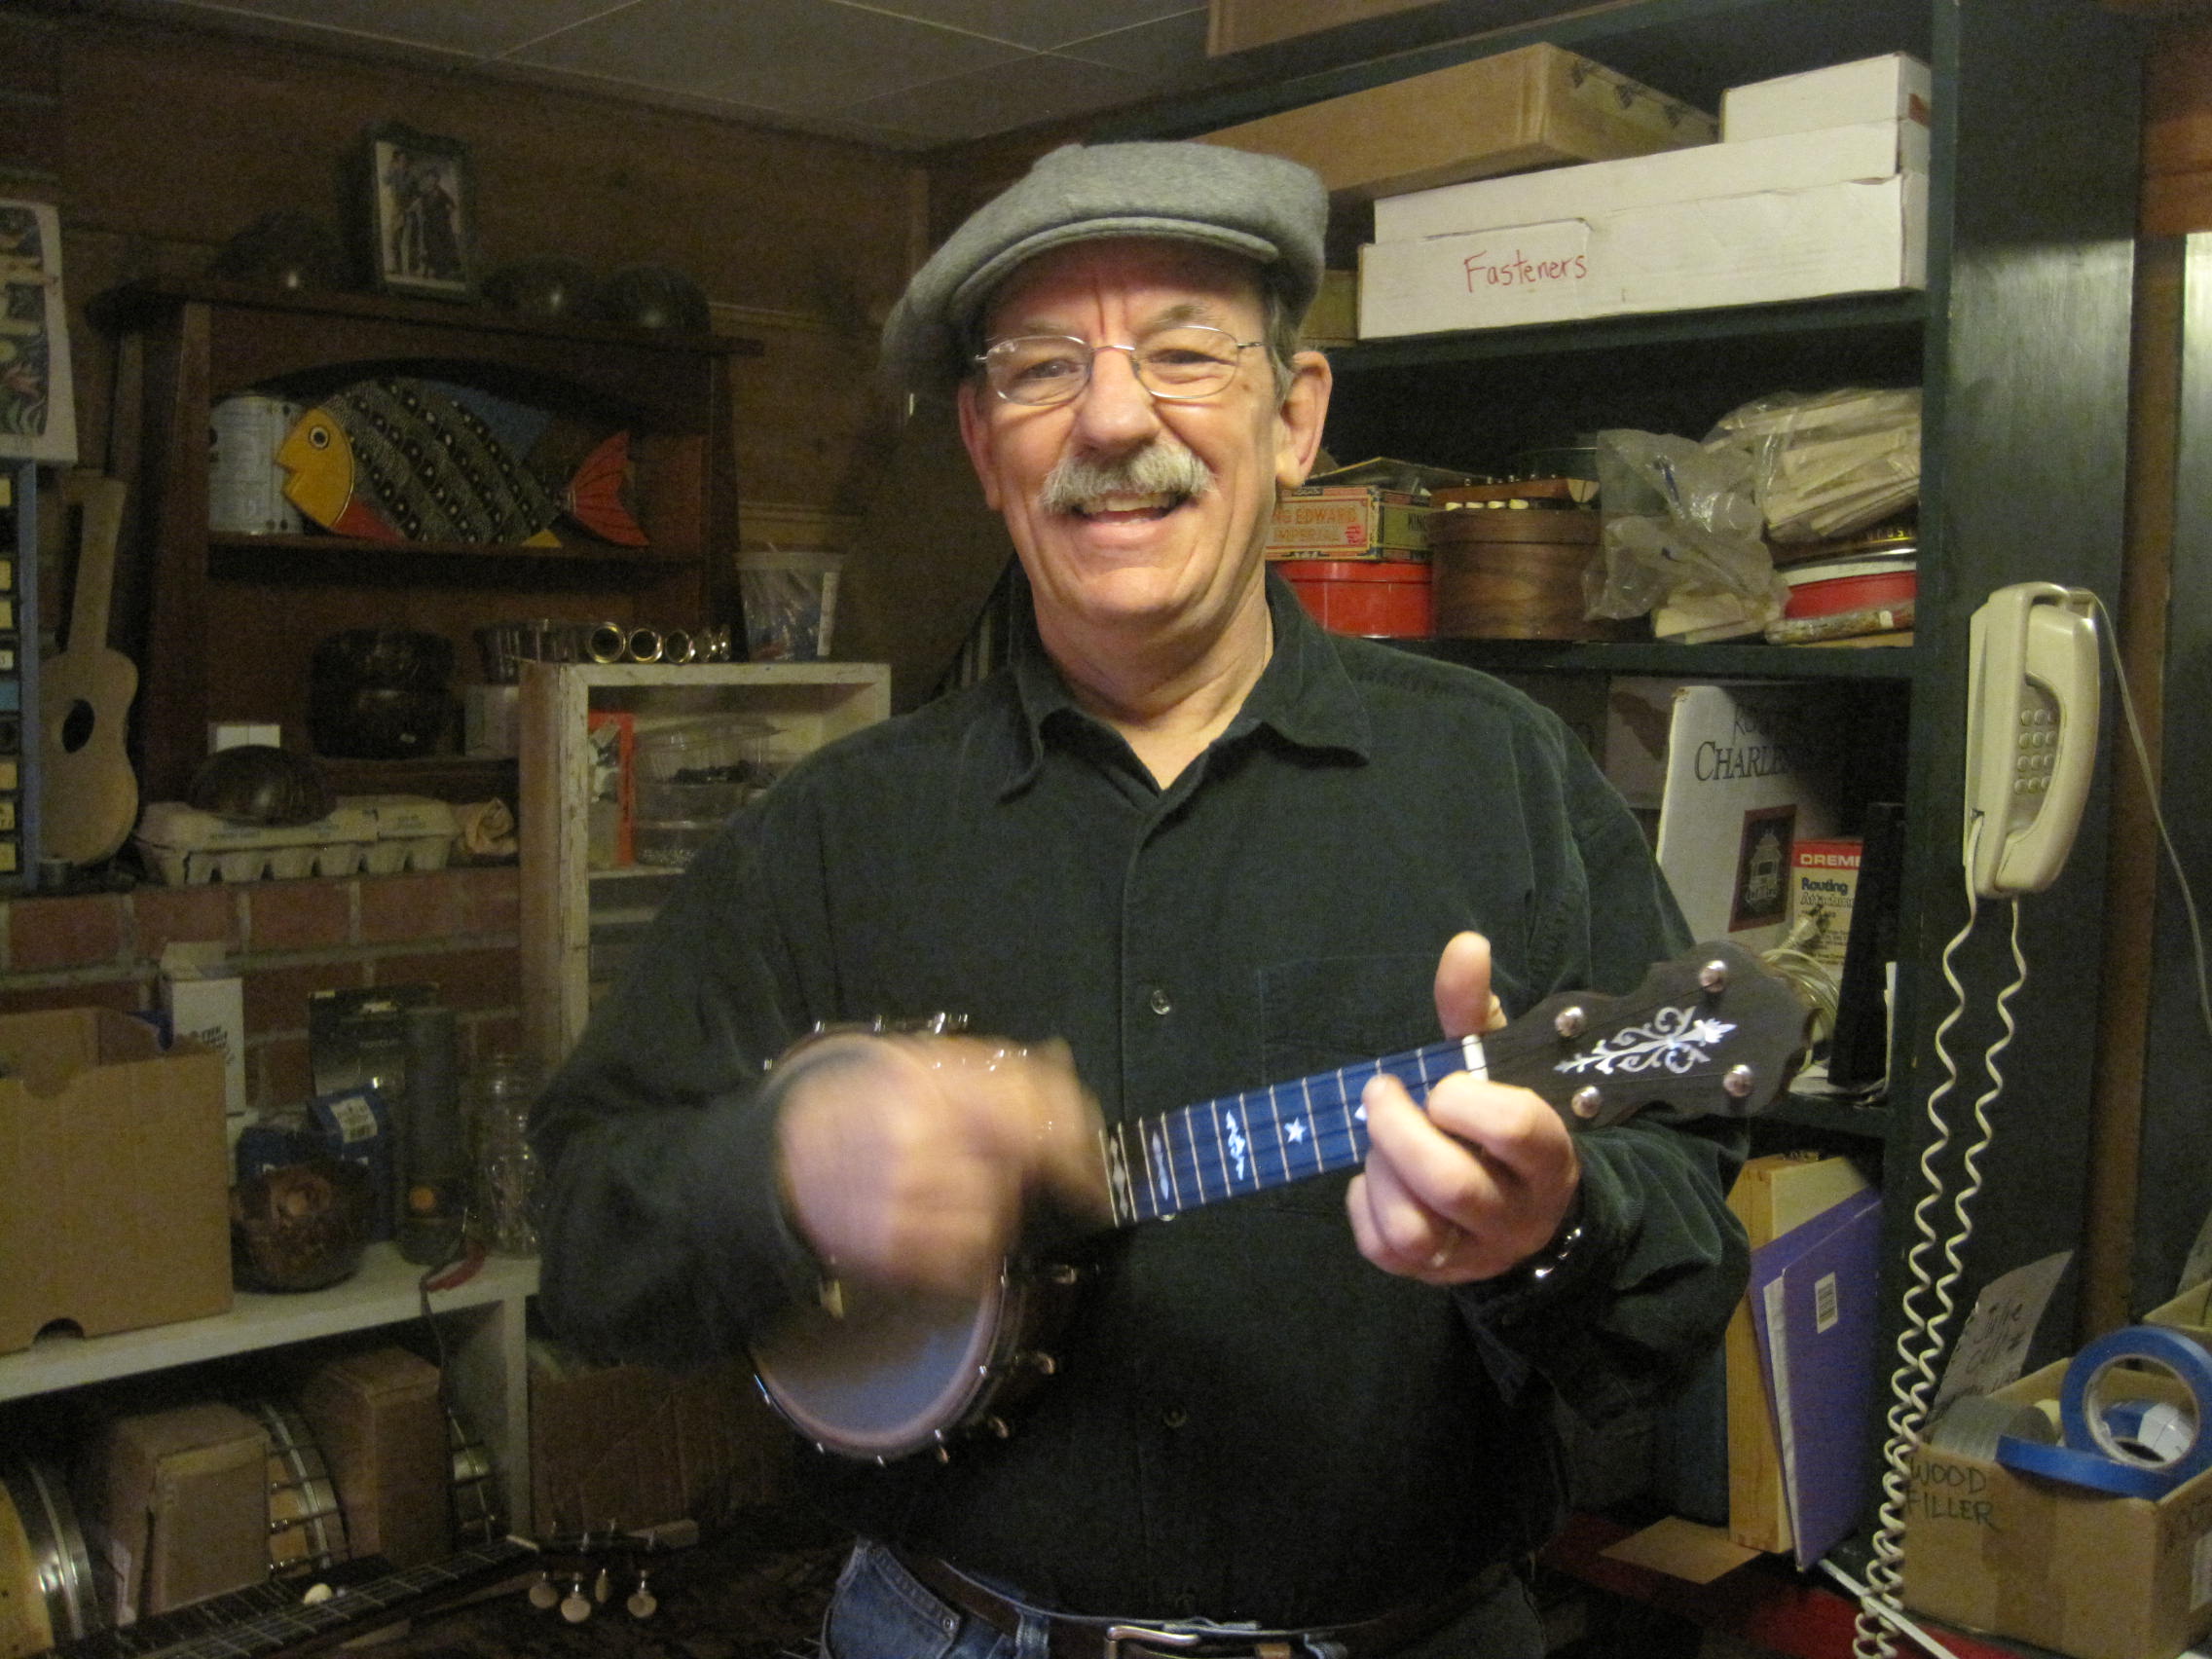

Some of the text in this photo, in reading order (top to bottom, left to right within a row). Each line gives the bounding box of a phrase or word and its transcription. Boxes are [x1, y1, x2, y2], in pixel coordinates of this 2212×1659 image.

[1463, 248, 1588, 293] Fasteners
[1296, 507, 1357, 525] EDWARD
[1801, 876, 1848, 896] Routing
[1909, 1457, 1986, 1494] WOOD
[1905, 1489, 2002, 1533] FILLER
